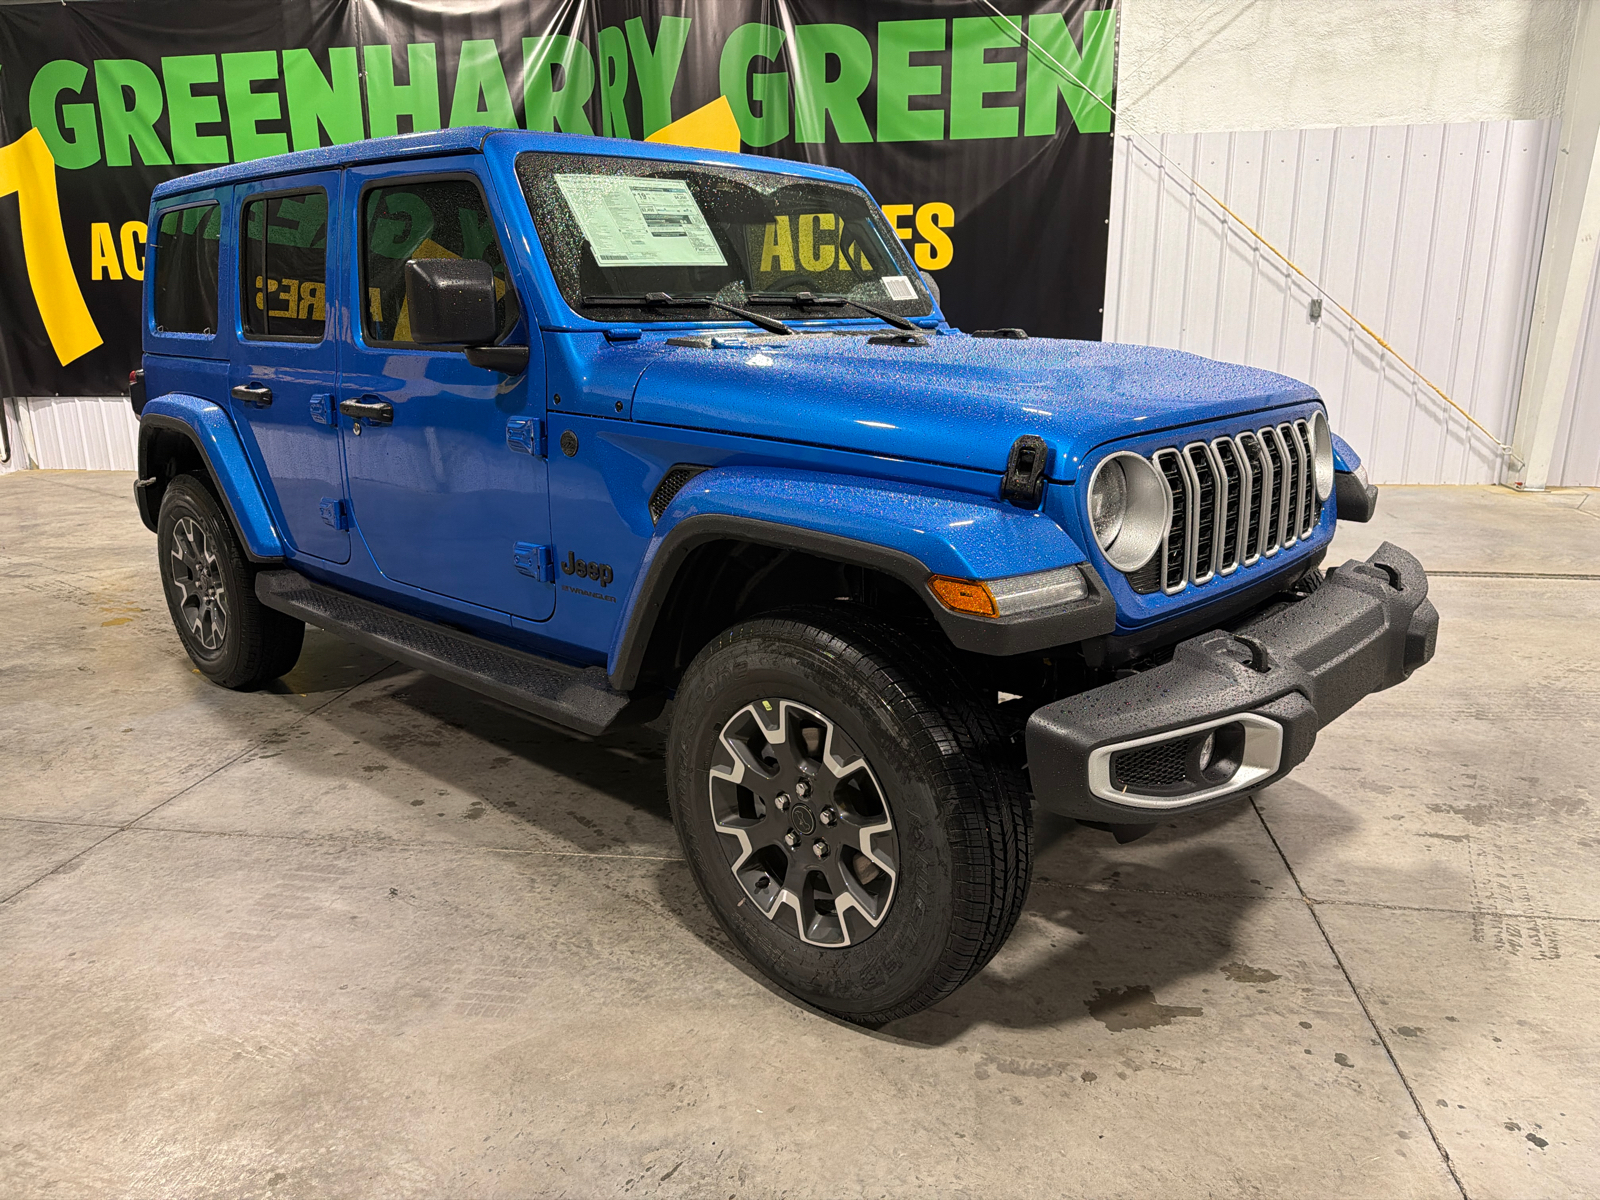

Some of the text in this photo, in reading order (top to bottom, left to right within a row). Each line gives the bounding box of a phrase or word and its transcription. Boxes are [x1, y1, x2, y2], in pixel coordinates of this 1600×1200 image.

[29, 47, 364, 170] GREEN
[363, 15, 692, 140] HARRY
[719, 9, 1115, 148] GREEN
[561, 550, 614, 588] Jeep
